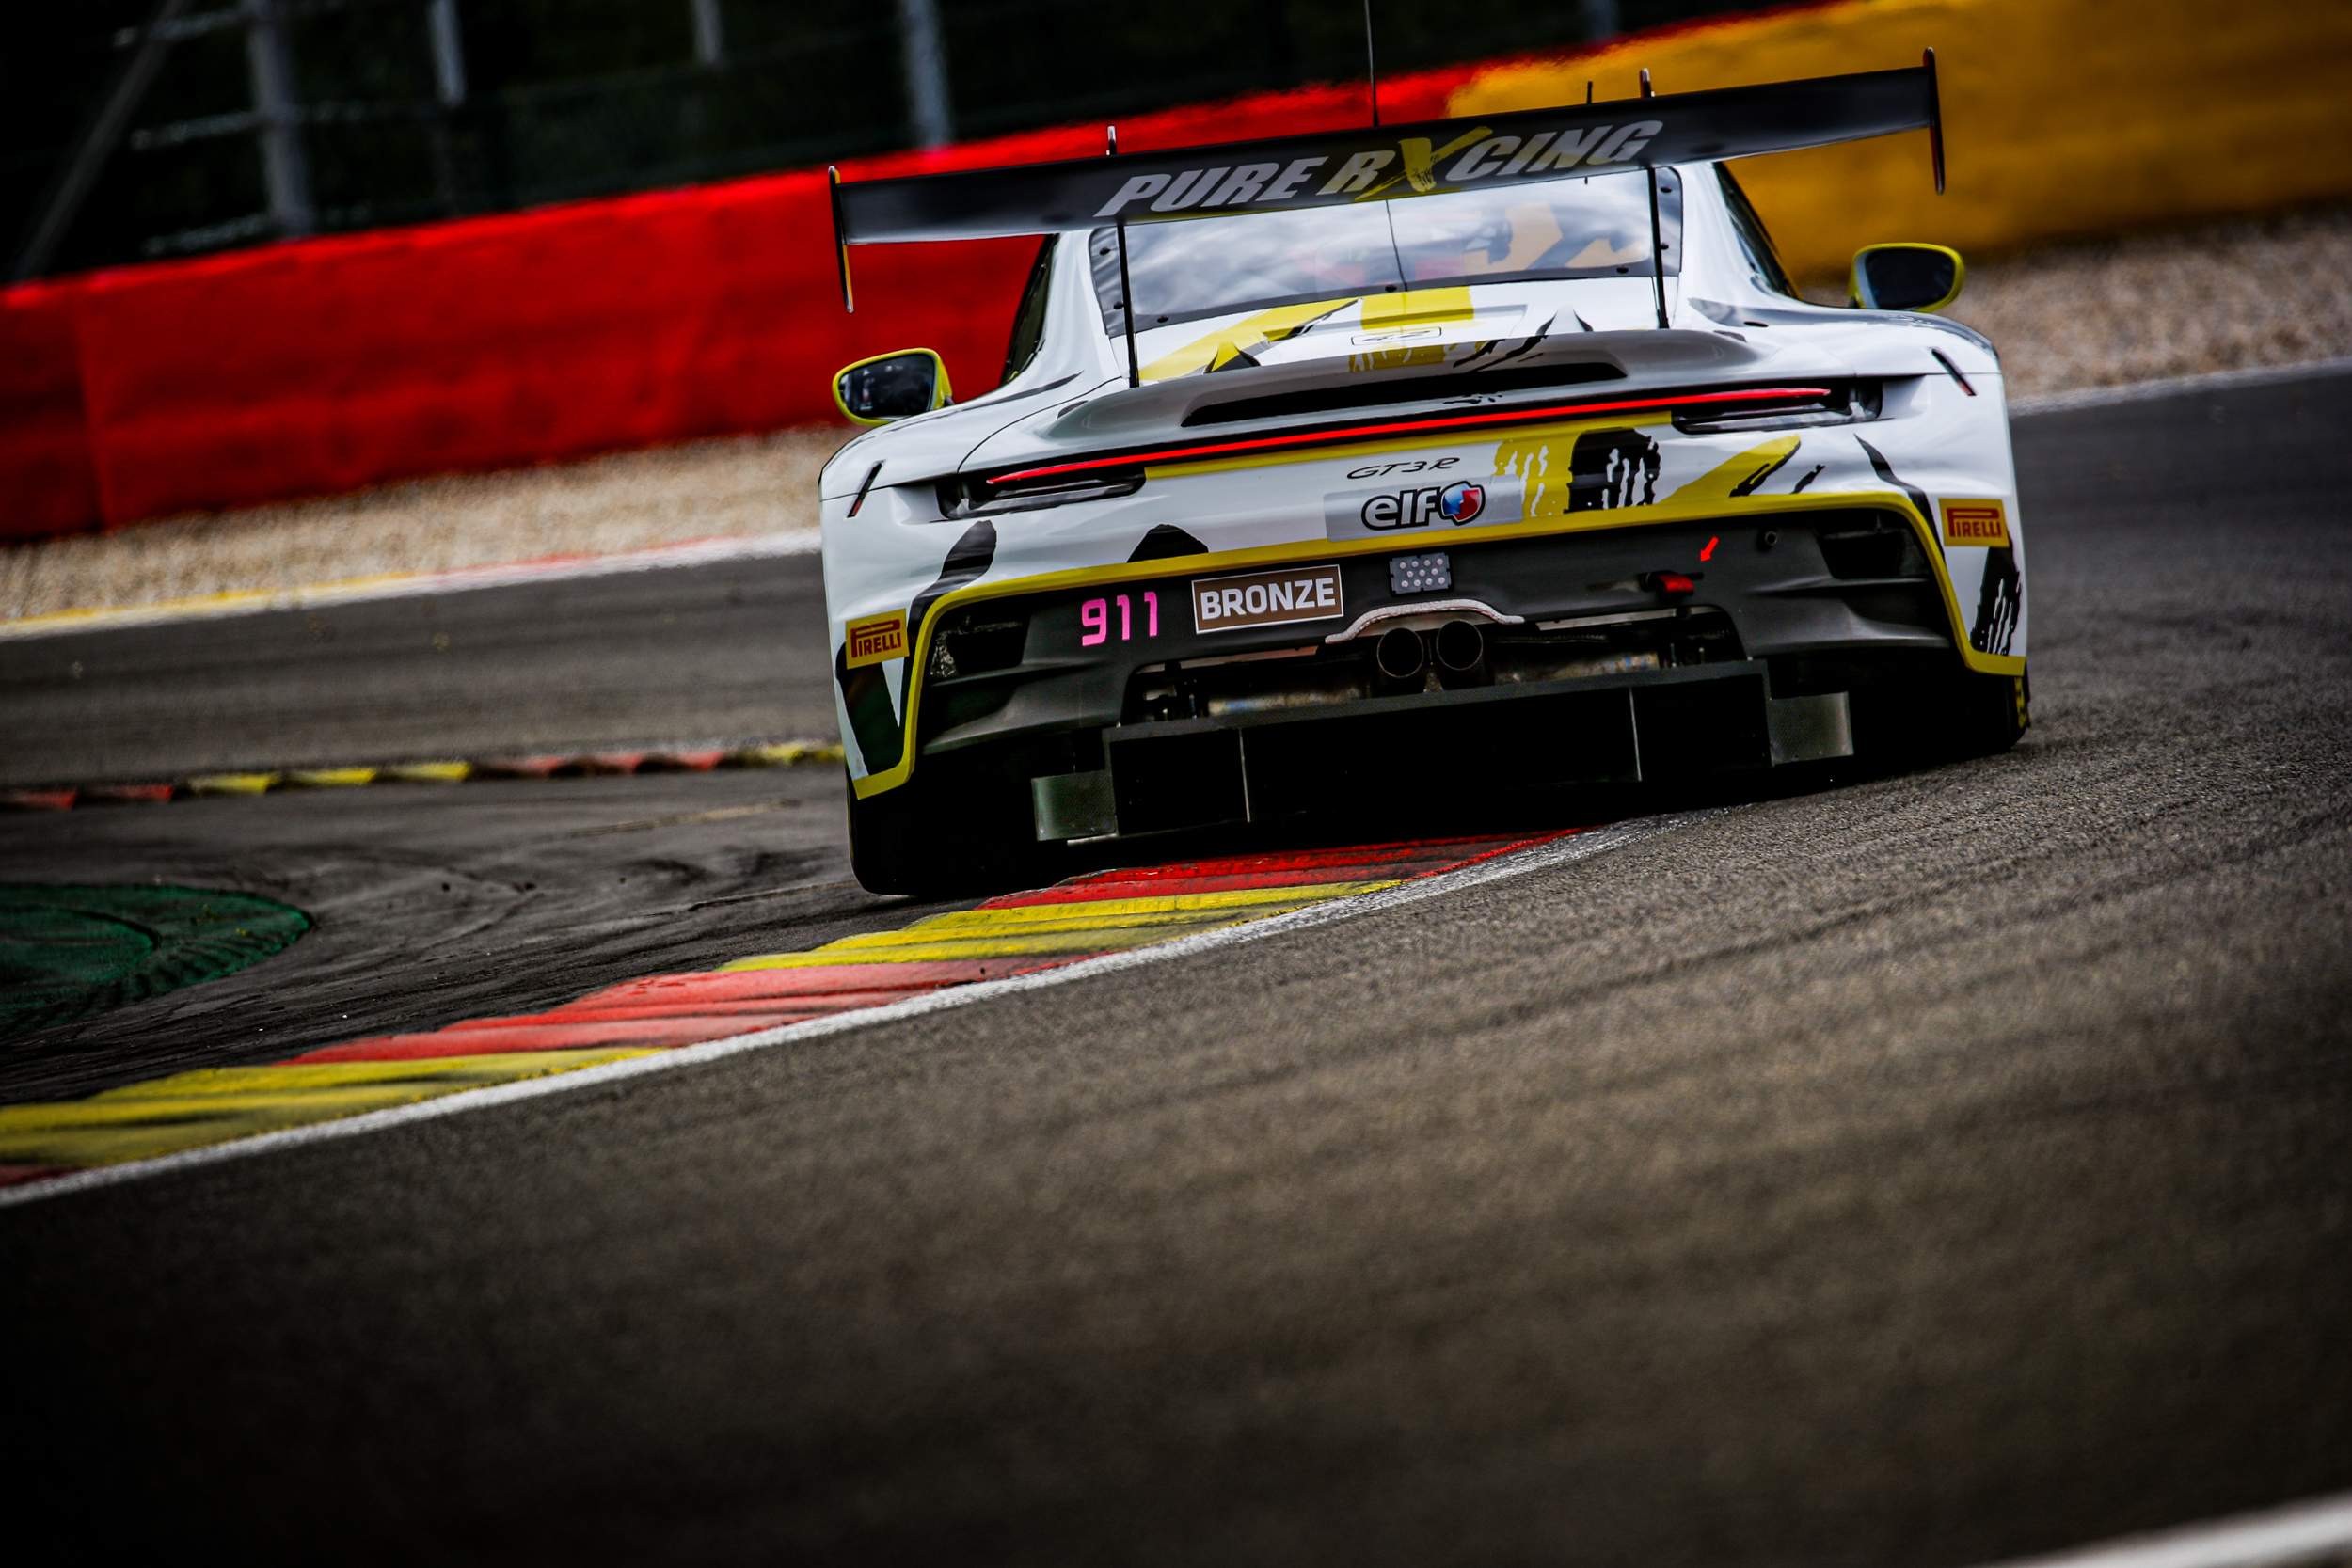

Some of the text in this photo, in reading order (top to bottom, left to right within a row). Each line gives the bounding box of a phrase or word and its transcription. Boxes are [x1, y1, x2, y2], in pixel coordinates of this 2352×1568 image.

[1093, 153, 1329, 217] PURE
[1362, 488, 1440, 531] elf
[1947, 508, 2003, 538] PIRELLI
[1082, 591, 1158, 646] 911
[1200, 577, 1336, 620] BRONZE
[850, 619, 902, 658] PIRELLI
